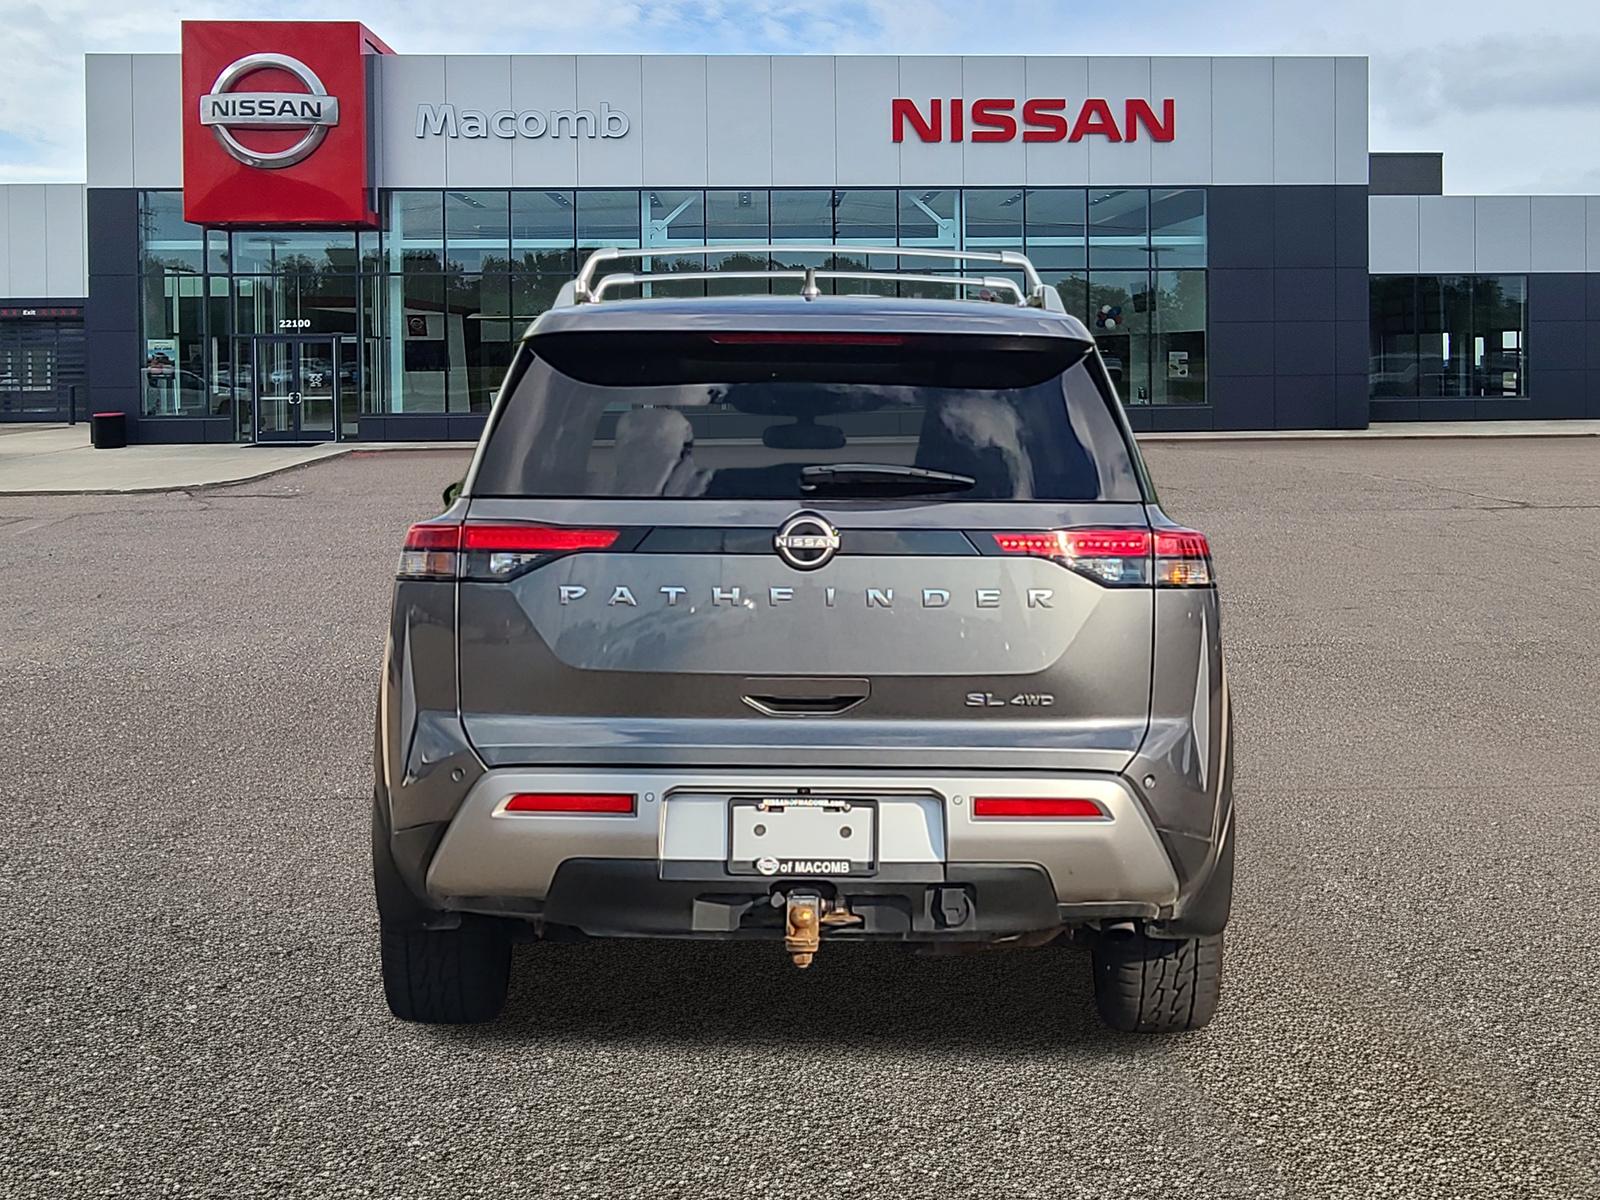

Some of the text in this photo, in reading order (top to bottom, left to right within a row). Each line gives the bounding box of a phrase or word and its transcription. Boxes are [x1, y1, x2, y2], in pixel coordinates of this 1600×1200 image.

[212, 100, 322, 118] NISSAN
[415, 102, 630, 139] Macomb
[892, 98, 1175, 143] NISSAN
[279, 319, 311, 328] 22100
[775, 536, 840, 549] NISSAN
[558, 585, 1054, 609] PATHFINDER
[965, 692, 1054, 707] SL 4WD
[780, 861, 793, 873] of
[795, 861, 850, 873] MACOMB
